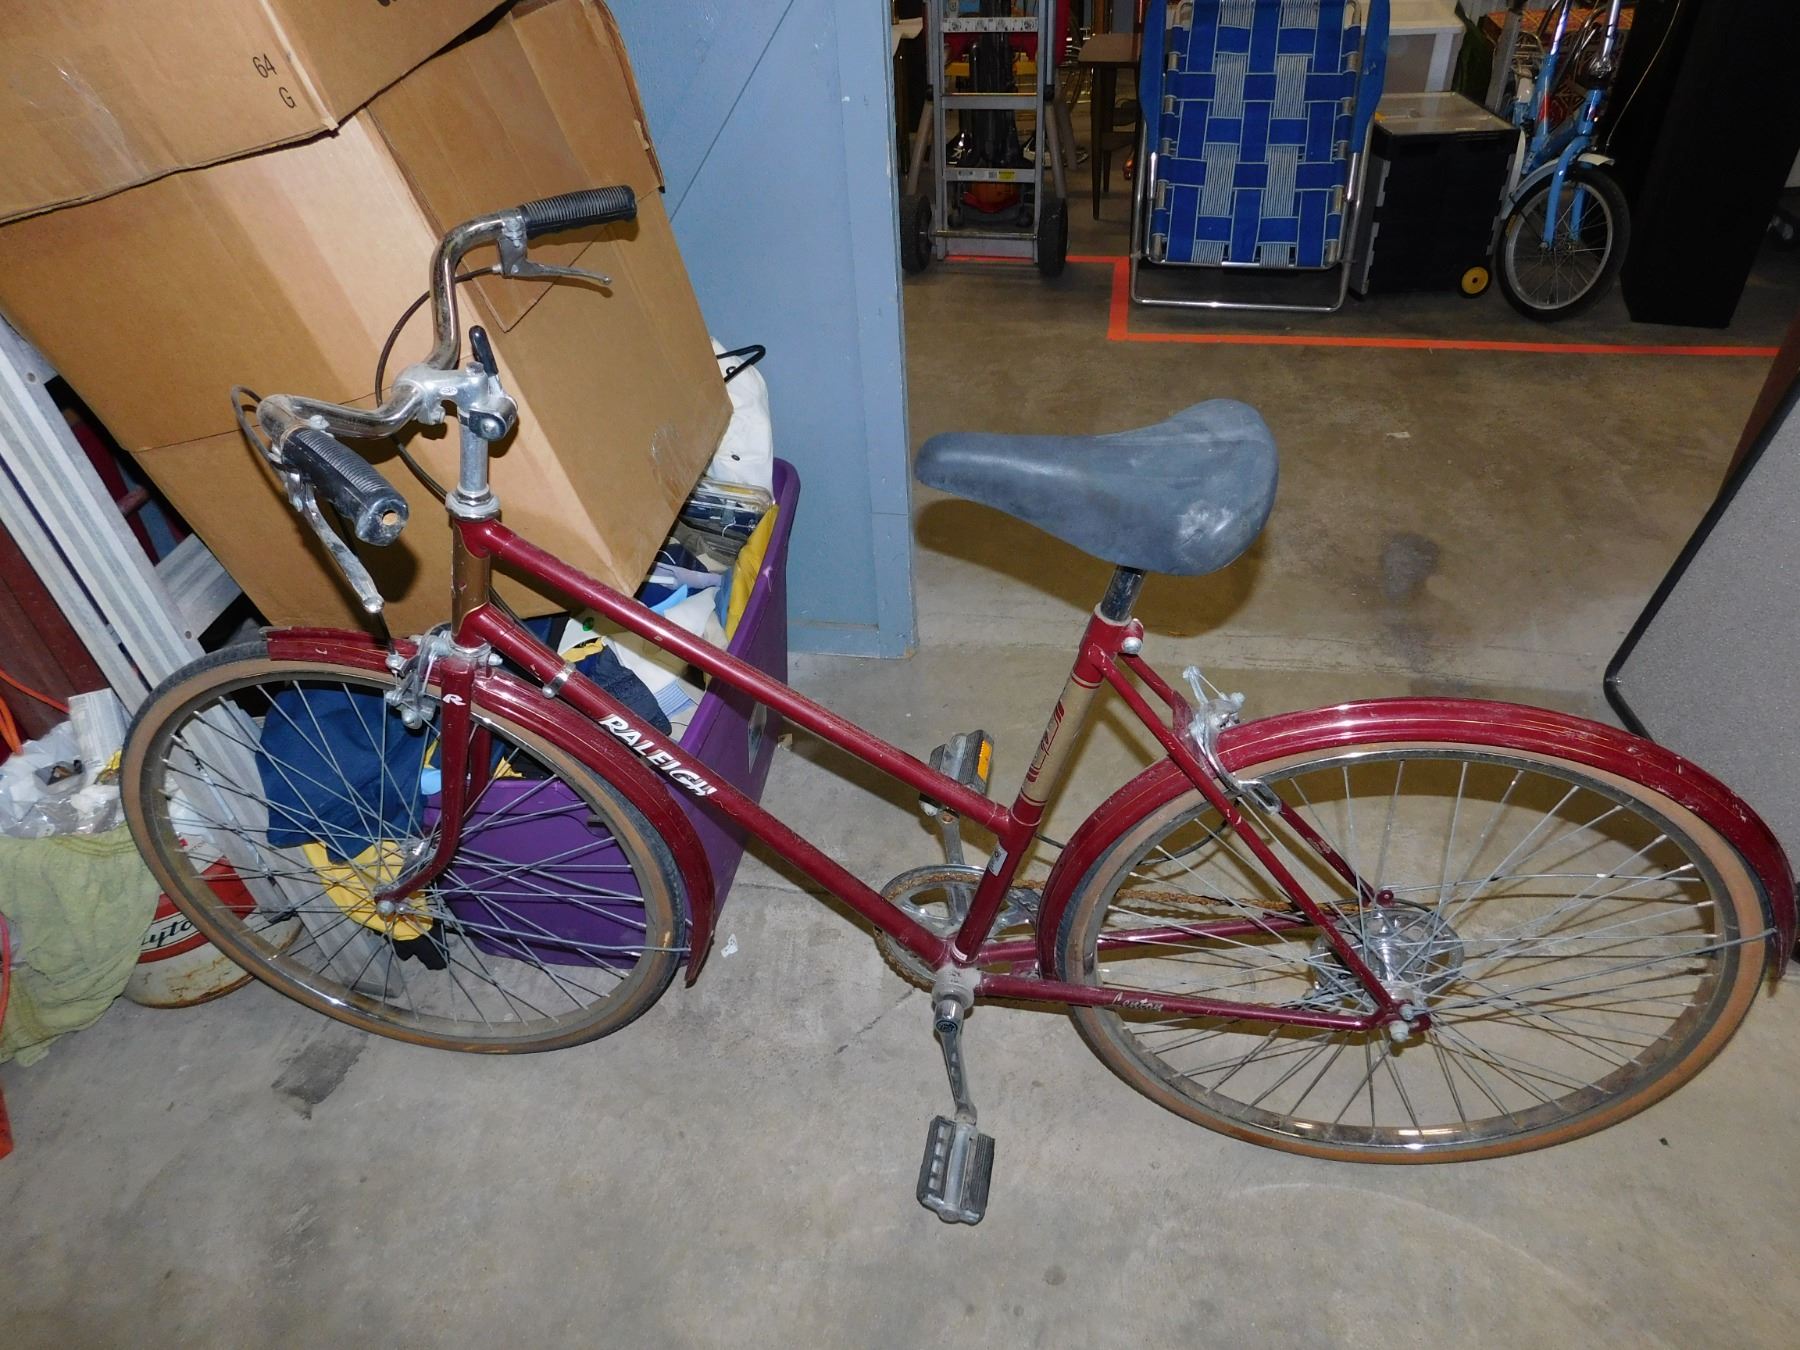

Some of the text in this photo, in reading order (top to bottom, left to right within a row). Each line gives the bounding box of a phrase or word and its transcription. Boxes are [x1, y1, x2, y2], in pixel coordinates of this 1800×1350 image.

[252, 53, 277, 78] 64
[278, 86, 297, 109] G
[442, 693, 467, 706] R
[599, 713, 718, 796] RALEIGH
